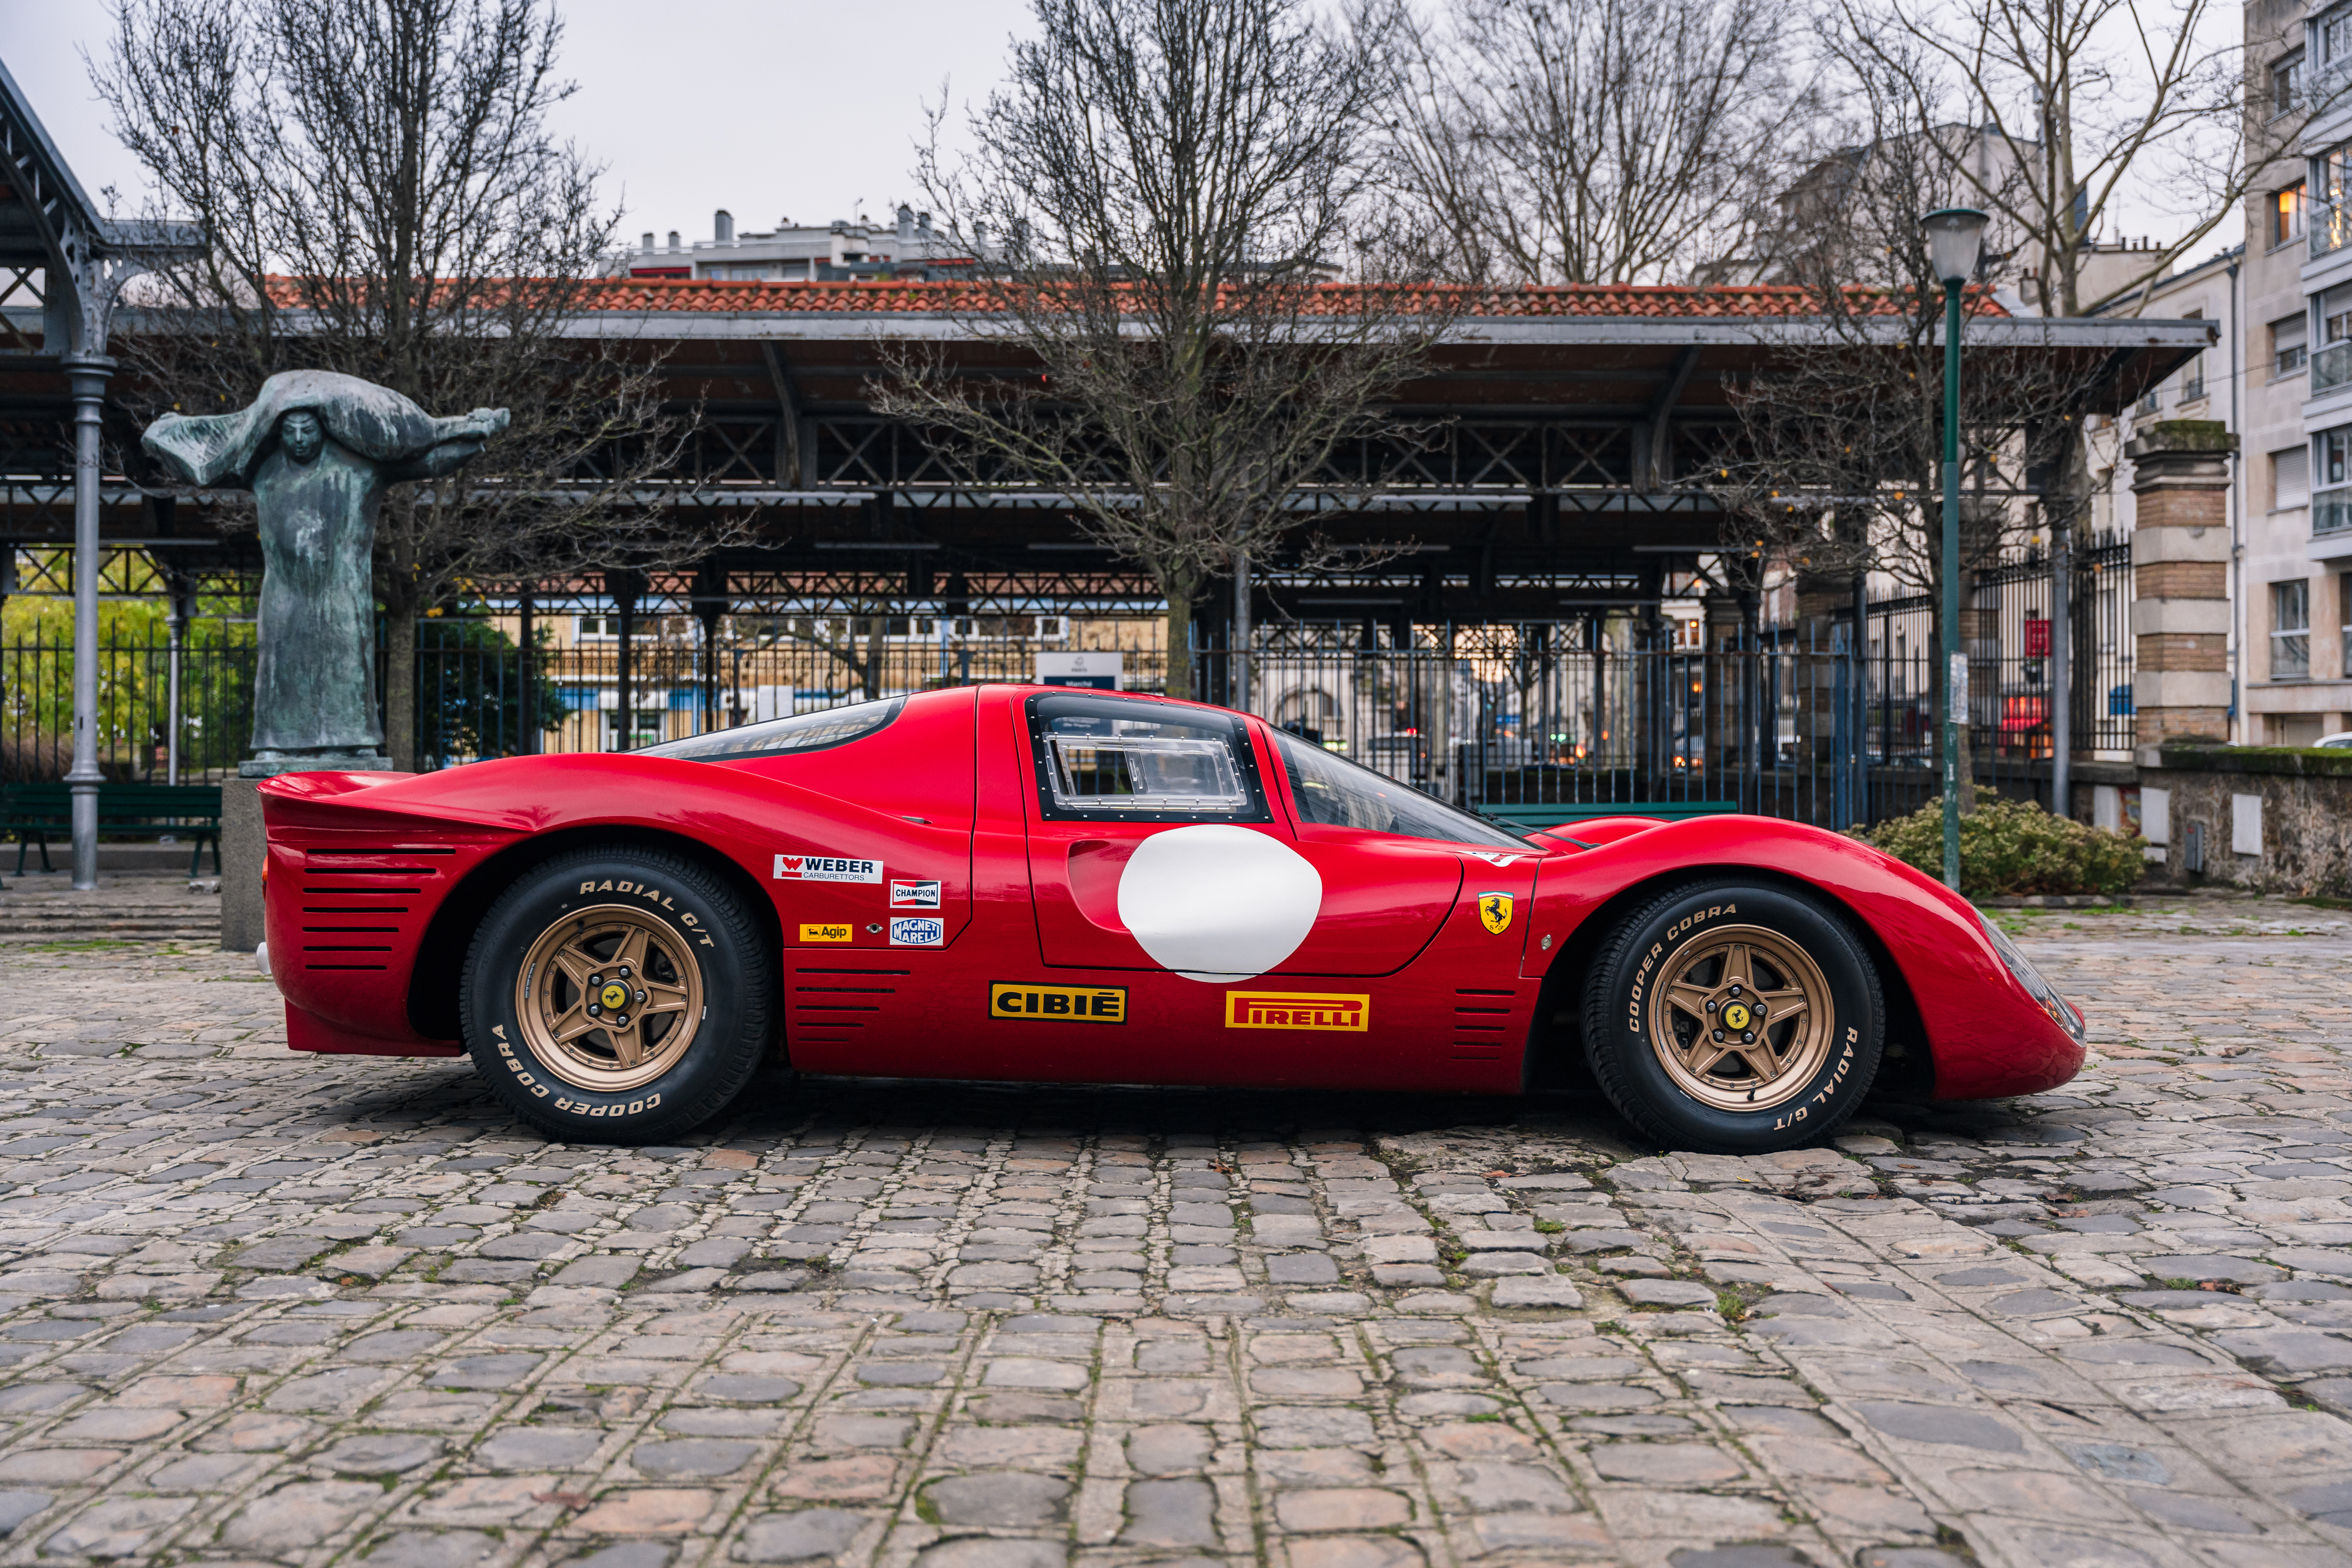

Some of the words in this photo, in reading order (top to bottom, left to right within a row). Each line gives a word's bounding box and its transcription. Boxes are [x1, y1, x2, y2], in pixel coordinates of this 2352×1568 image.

[803, 872, 864, 881] CARBURETTORS
[805, 858, 874, 874] WEBER
[896, 889, 936, 897] CHAMPION
[580, 880, 674, 911] RADIAL
[681, 912, 716, 948] G/T
[821, 926, 847, 938] Agip
[894, 920, 940, 934] MAGNETI
[894, 930, 940, 943] MARELLI
[1629, 942, 1663, 1033] COOPER
[1667, 904, 1737, 941] COBRA
[997, 992, 1120, 1017] CIBIÉ
[1234, 997, 1362, 1027] PIRELLI
[492, 1025, 550, 1098] COBRA
[1813, 1027, 1858, 1104] RADIAL
[554, 1093, 661, 1117] COOPER
[1773, 1106, 1808, 1131] G/T
